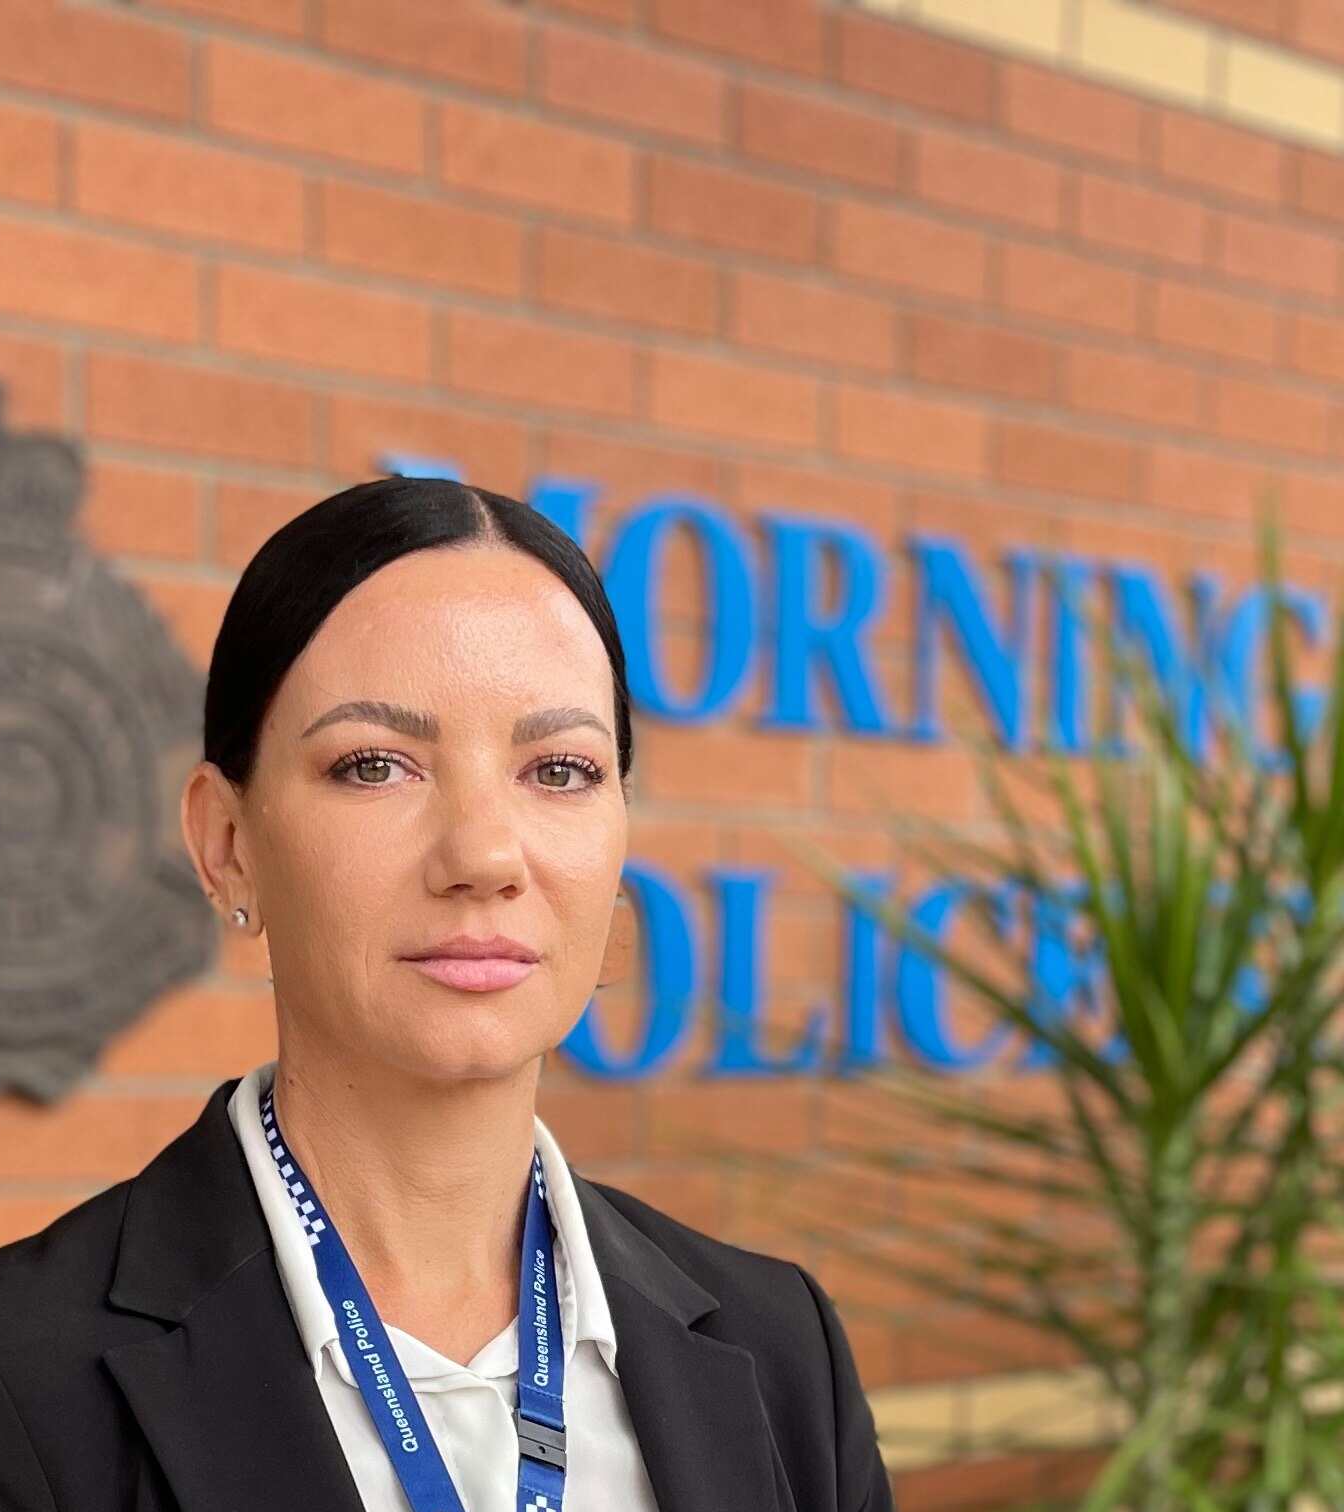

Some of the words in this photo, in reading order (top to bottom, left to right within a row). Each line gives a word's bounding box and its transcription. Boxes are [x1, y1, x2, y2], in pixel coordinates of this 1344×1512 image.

[558, 858, 1132, 1084] OLICE
[533, 1249, 546, 1294] Police
[342, 1300, 374, 1350] Police
[533, 1295, 549, 1387] Queensland
[364, 1353, 419, 1453] Queensland
